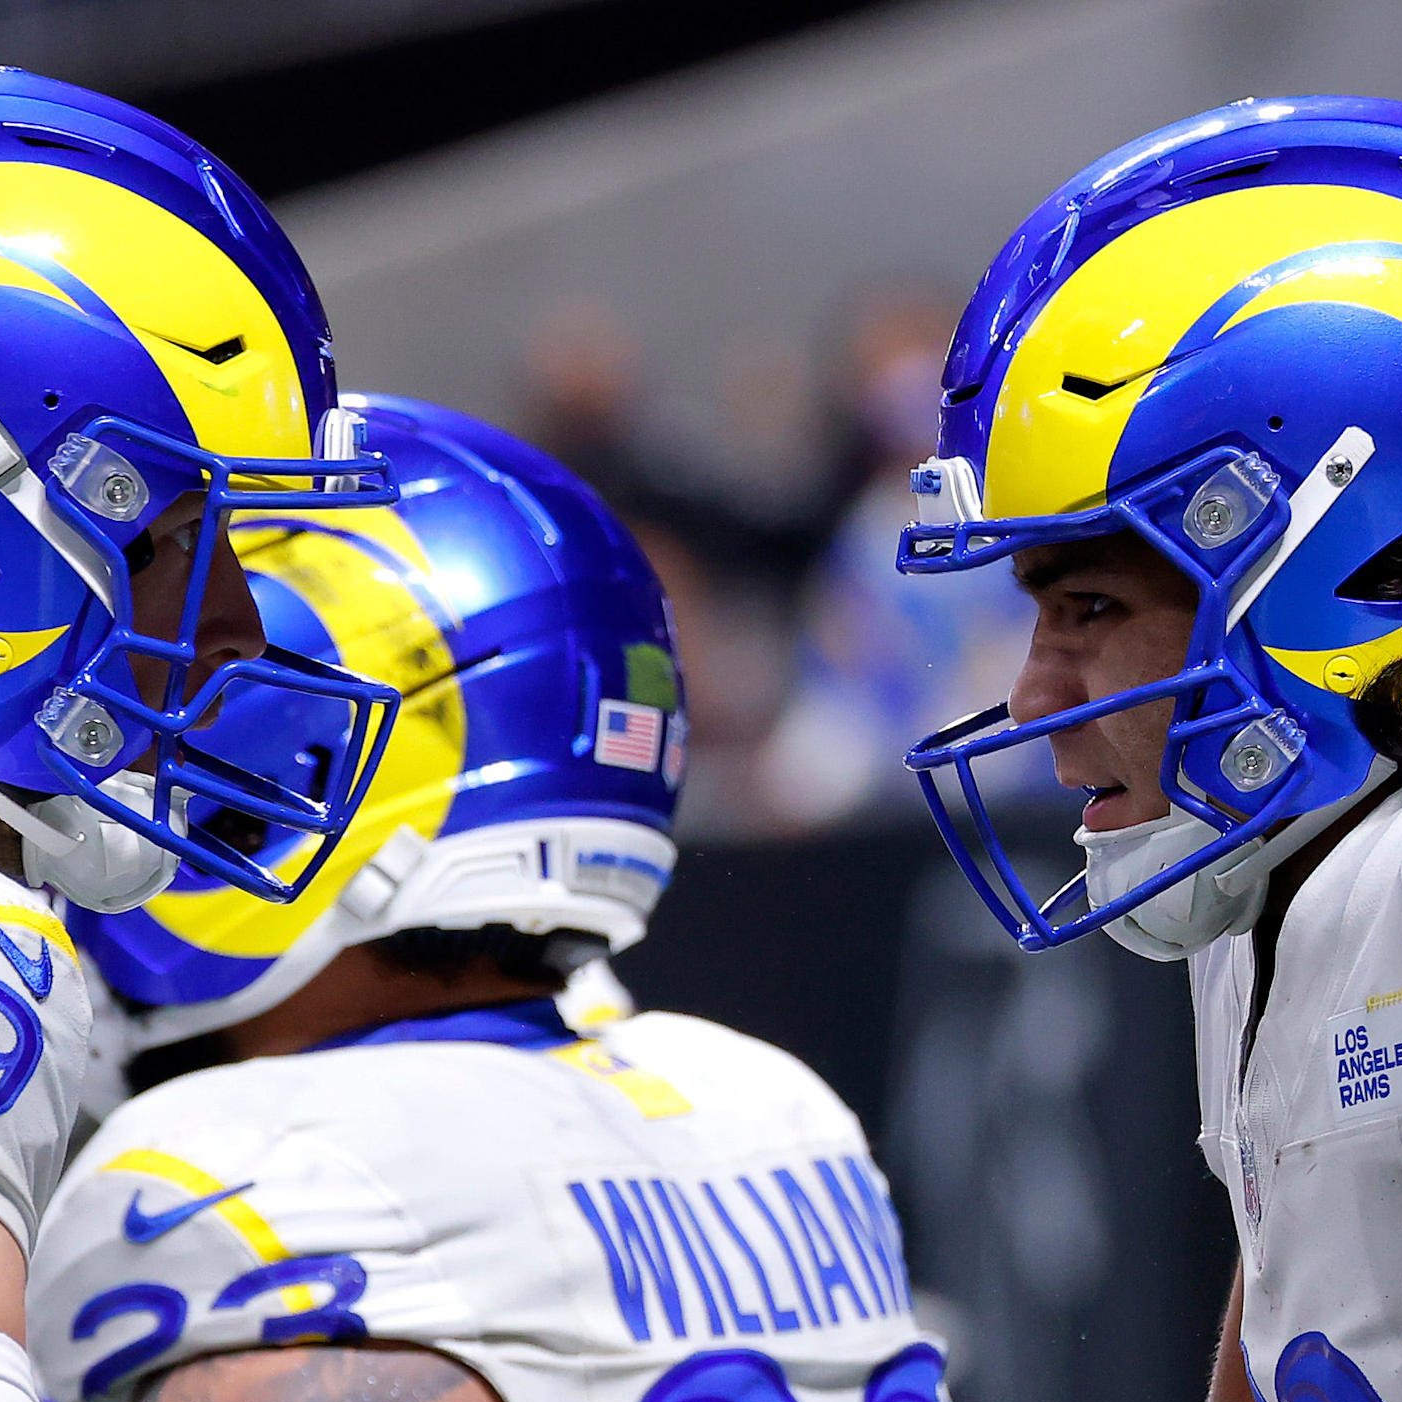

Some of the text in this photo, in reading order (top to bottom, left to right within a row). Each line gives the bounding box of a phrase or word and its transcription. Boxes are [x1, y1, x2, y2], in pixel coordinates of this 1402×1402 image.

[1334, 1025, 1369, 1056] LOS
[1339, 1074, 1391, 1109] RAMS
[567, 1156, 914, 1342] WILLIAM
[72, 1253, 368, 1402] 23
